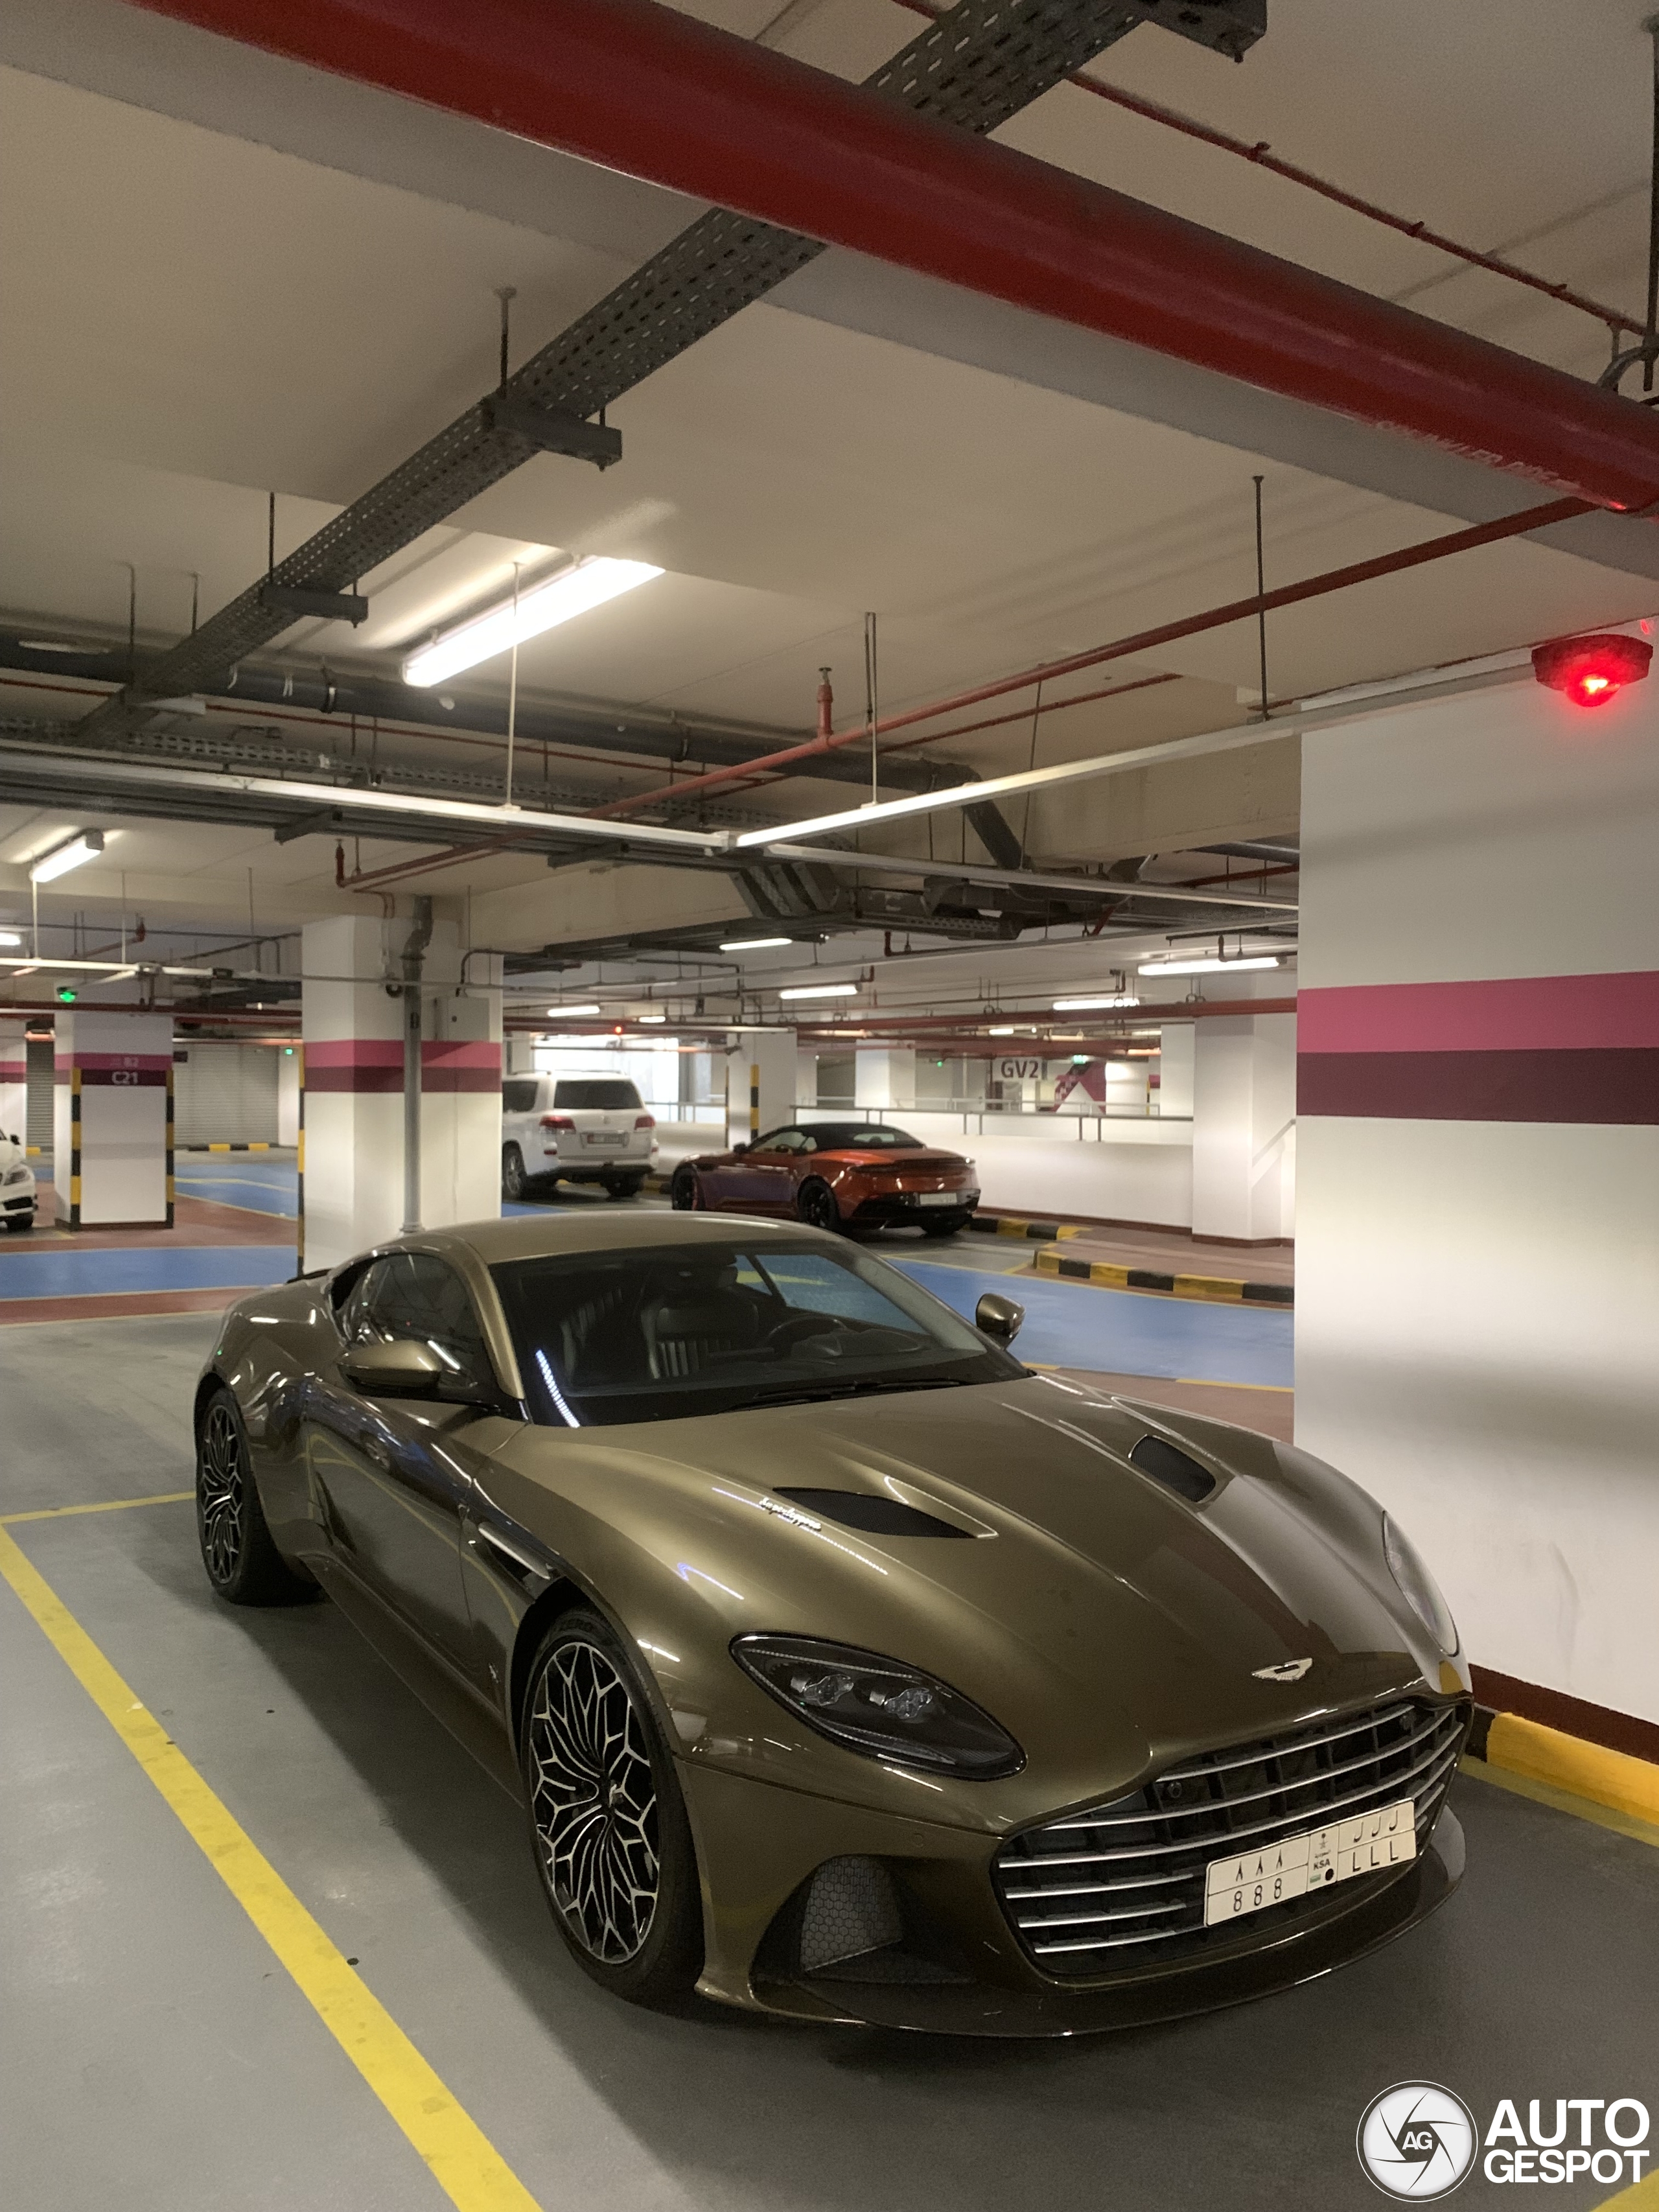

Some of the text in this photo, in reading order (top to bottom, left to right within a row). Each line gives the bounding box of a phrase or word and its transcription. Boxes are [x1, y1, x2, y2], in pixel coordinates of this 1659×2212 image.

[1001, 1059, 1039, 1079] GV2
[111, 1071, 139, 1085] C21
[1313, 1857, 1331, 1871] KSA
